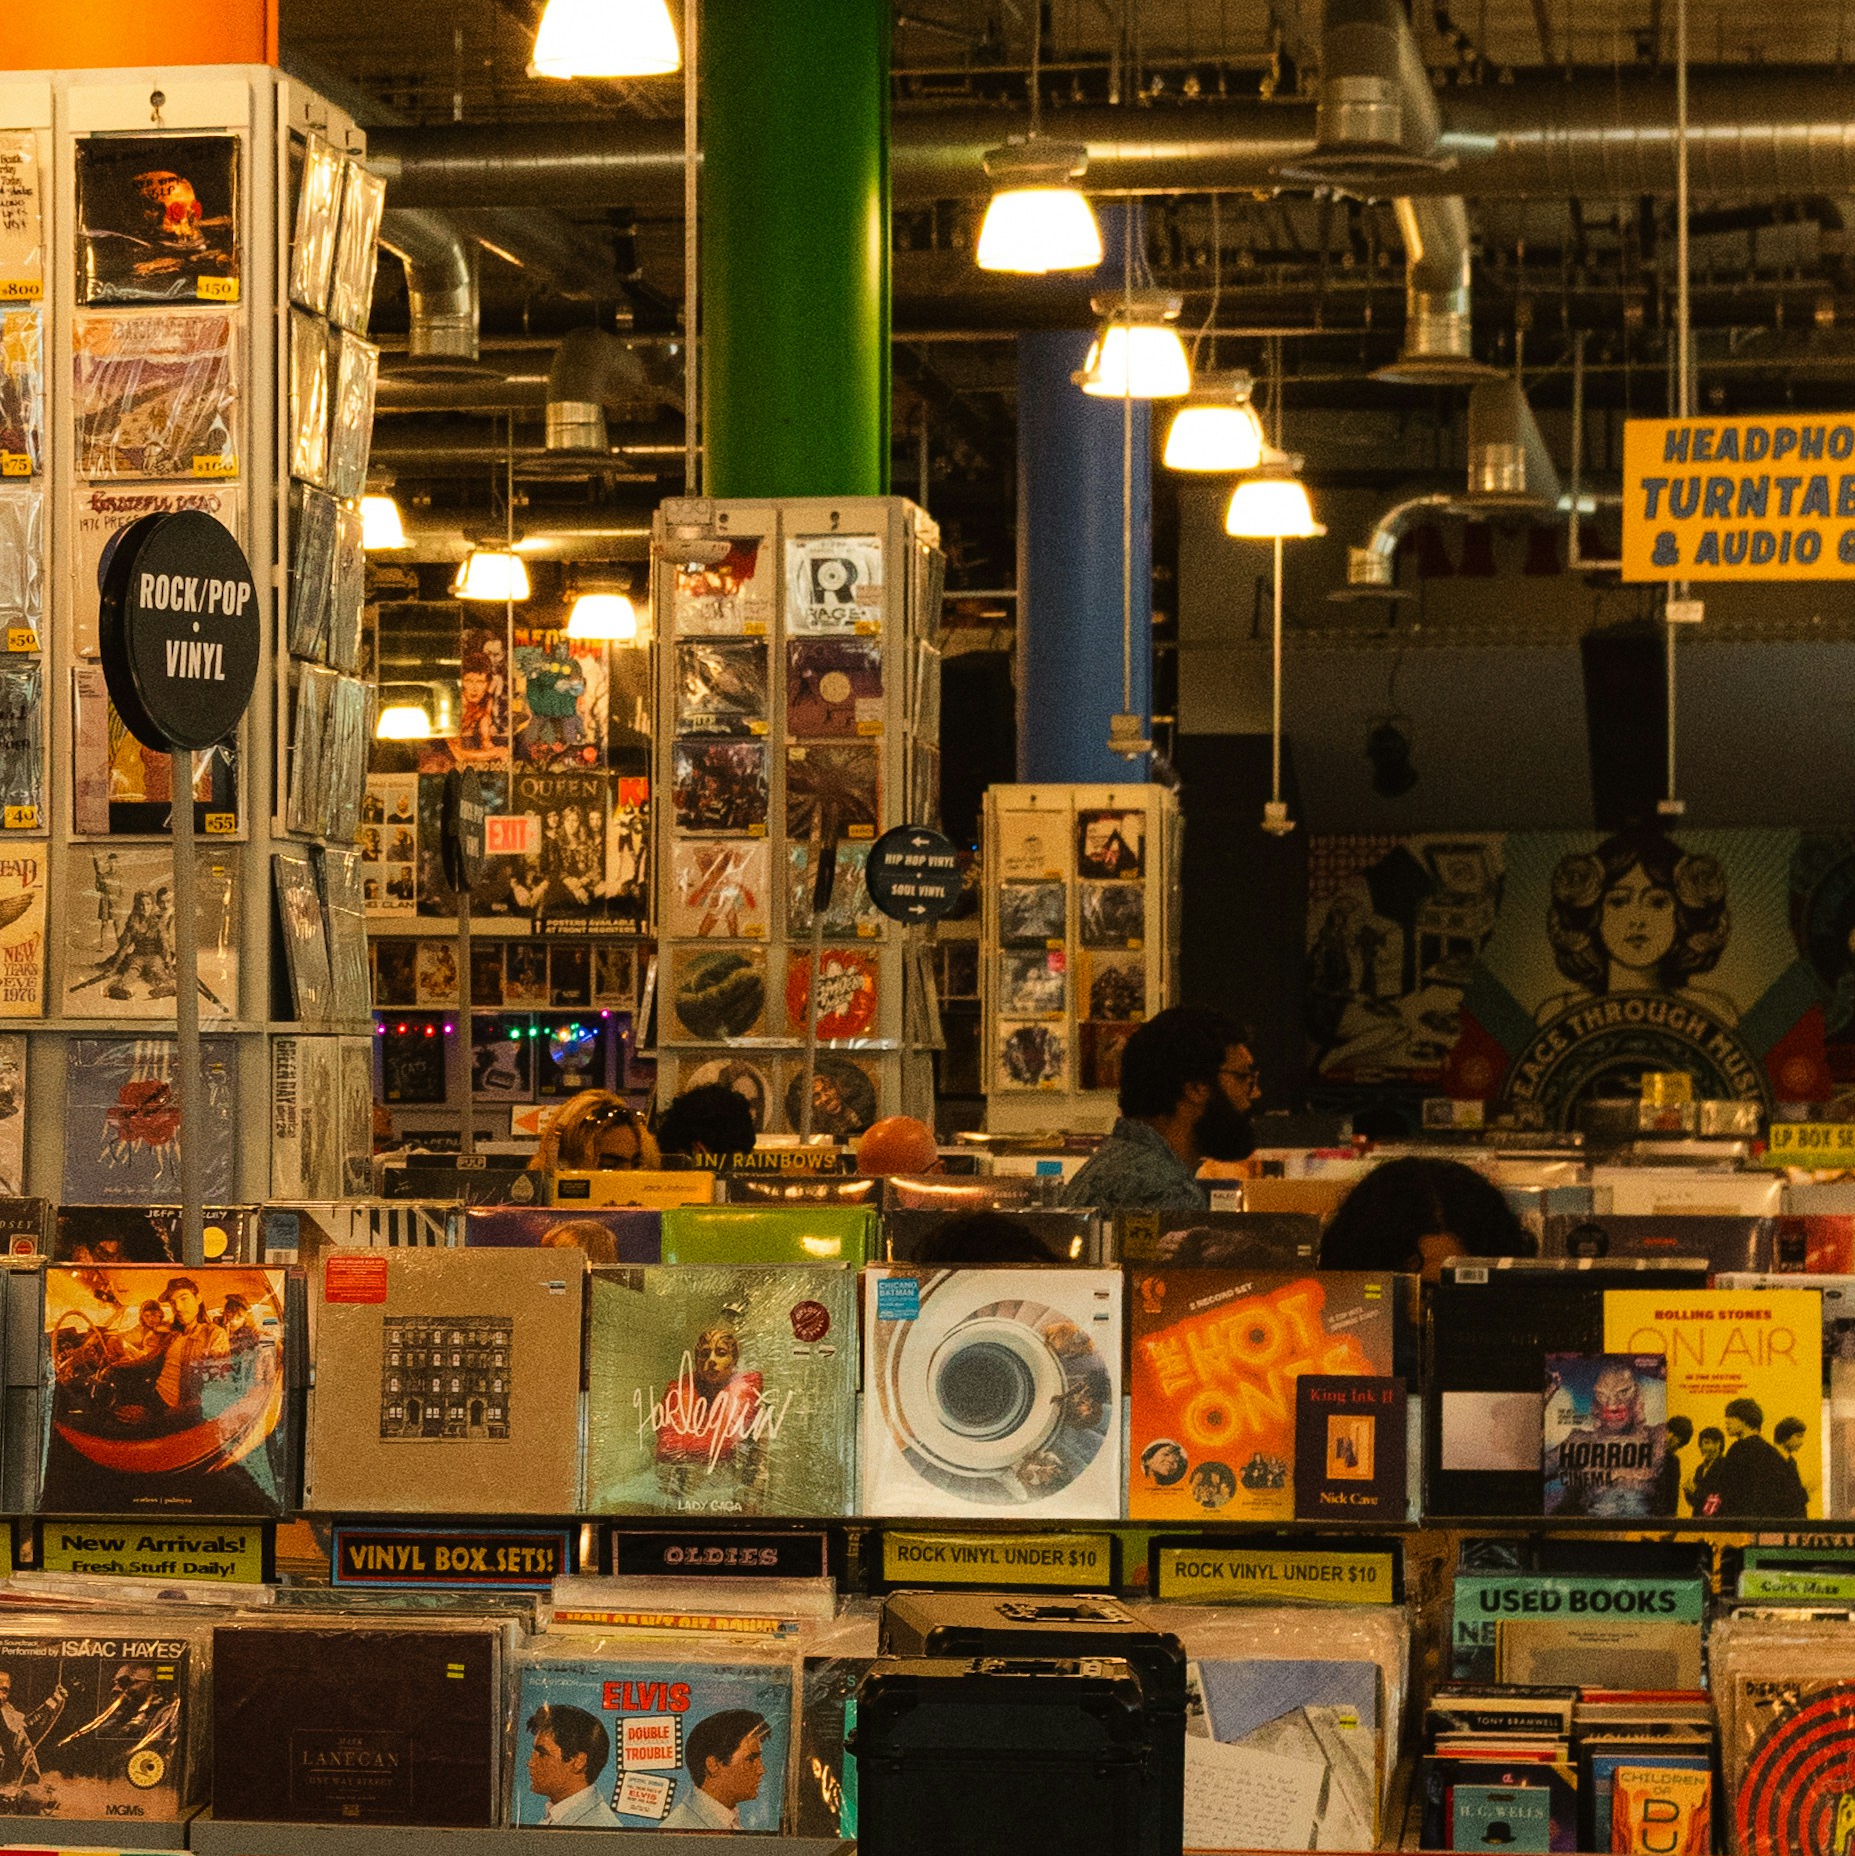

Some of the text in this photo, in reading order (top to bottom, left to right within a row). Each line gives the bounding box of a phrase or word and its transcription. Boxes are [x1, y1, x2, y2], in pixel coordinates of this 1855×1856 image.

[2, 283, 39, 296] $800
[1664, 426, 1855, 464] HEADPHO
[1651, 531, 1680, 567] &
[1696, 530, 1823, 565] AUDIO
[140, 573, 251, 617] ROCK/POP
[166, 639, 225, 681] VINYL
[520, 776, 599, 799] QUEEN
[488, 818, 529, 851] EXIT
[885, 853, 955, 869] HIP HOP VINYL
[891, 883, 946, 898] SOUL VINYL
[3, 933, 41, 962] NEW
[4, 963, 38, 977] YEARS
[3, 988, 36, 1003] 1976
[1567, 999, 1706, 1039] THROUGH
[732, 1152, 836, 1169] RAINBOWS
[1654, 1309, 1773, 1321] ROLLING STONES
[1627, 1327, 1797, 1367] ON AIR
[1558, 1443, 1655, 1469] HORROR
[1559, 1470, 1613, 1487] CINEMA
[677, 1500, 743, 1512] LADY GAGA
[1319, 1492, 1379, 1506] Nick Cave
[61, 1533, 247, 1555] New Arrivals!
[349, 1544, 554, 1573] VINYL BOX SETS!
[663, 1546, 779, 1567] OLDIES
[897, 1545, 1098, 1569] ROCK VINYL UNDER $10
[71, 1559, 236, 1578] Fresh Stuff Daily!
[1175, 1562, 1377, 1584] ROCK VINYL UNDER $10
[1479, 1589, 1678, 1614] USED BOOKS
[61, 1640, 182, 1659] ISAAC HAYES
[602, 1680, 692, 1713] ELVIS
[1476, 1715, 1559, 1727] TONY BRAMWELL
[628, 1725, 670, 1741] DOUBLE
[625, 1746, 673, 1761] TROUBLE
[1620, 1772, 1706, 1786] CHILDREN
